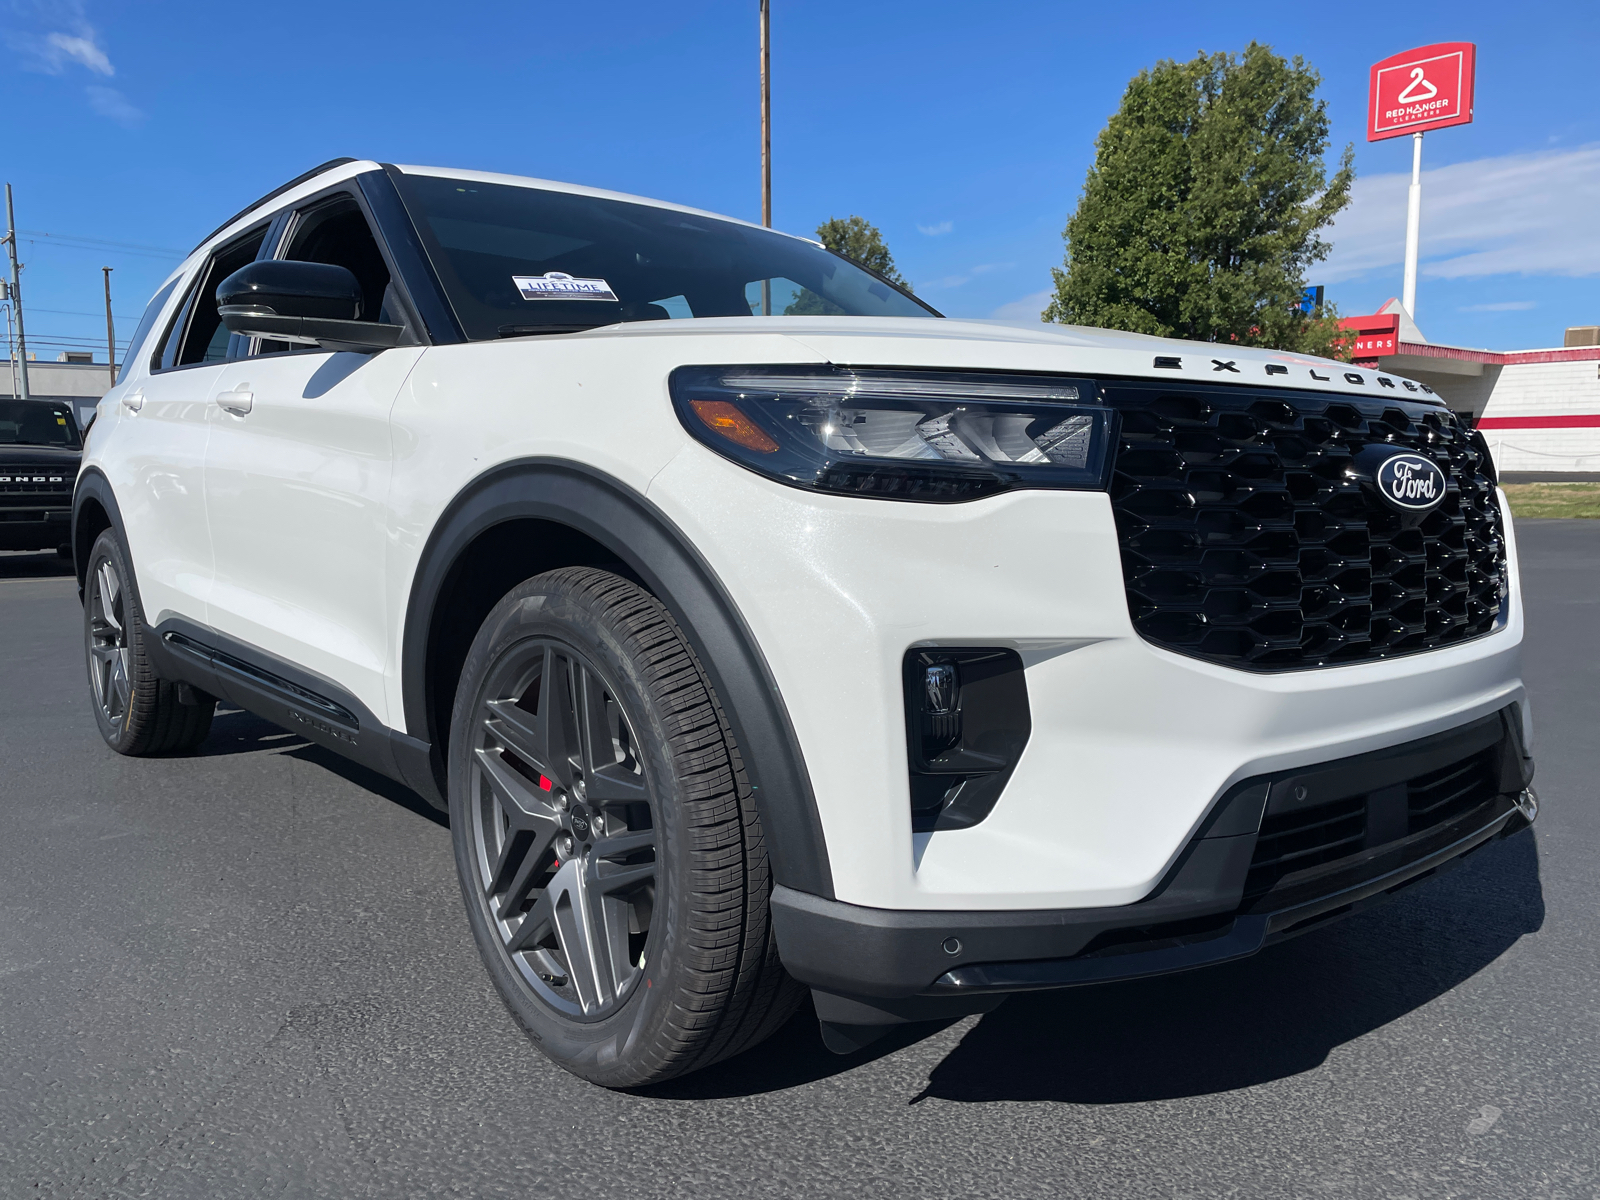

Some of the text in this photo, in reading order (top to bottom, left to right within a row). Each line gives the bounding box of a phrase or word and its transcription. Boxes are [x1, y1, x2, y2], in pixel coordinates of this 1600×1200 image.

[1386, 99, 1449, 119] RED HANGER
[1393, 109, 1440, 123] CLEANERS
[528, 282, 600, 291] LIFETIME
[1153, 356, 1434, 394] EXPLORER
[1392, 461, 1436, 499] Ford
